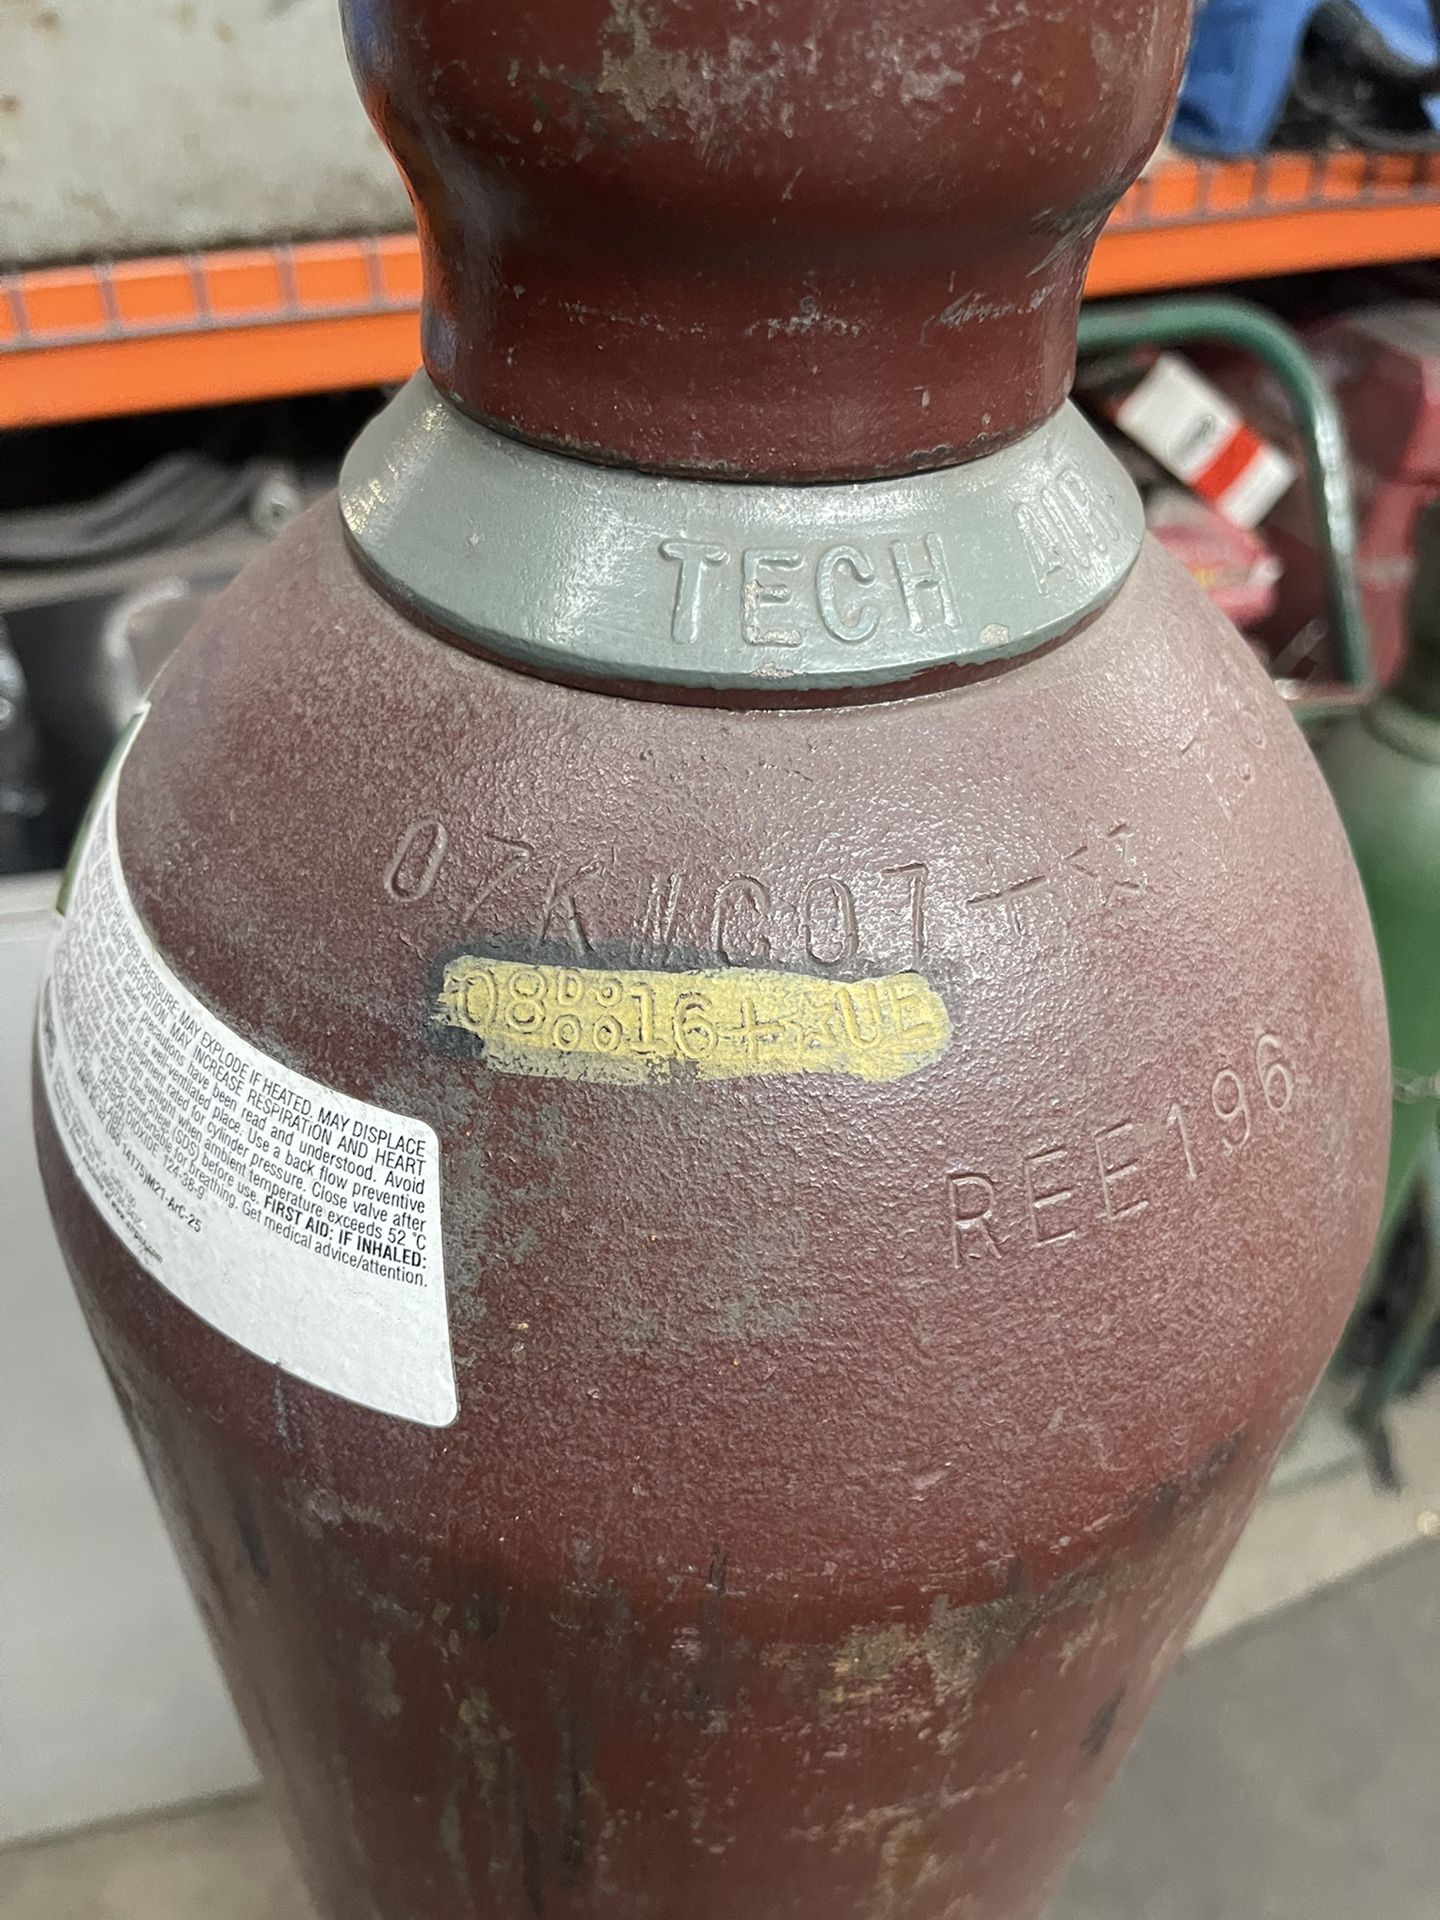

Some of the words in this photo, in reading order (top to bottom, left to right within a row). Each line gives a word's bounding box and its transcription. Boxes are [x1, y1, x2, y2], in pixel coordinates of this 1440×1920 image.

[658, 532, 962, 647] TECH
[1013, 468, 1122, 595] AIR
[125, 1110, 159, 1158] DIOXIDE
[162, 1154, 206, 1200] 124-38-9
[126, 1051, 143, 1079] from
[144, 1077, 176, 1119] sunlight
[178, 1113, 203, 1144] when
[204, 1138, 247, 1177] ambient
[249, 1166, 324, 1218] temperature
[327, 1211, 383, 1240] exceeds
[387, 1228, 406, 1247] 52
[128, 1034, 168, 1088] equipment
[167, 1083, 190, 1112] rated
[191, 1104, 206, 1125] for
[207, 1121, 249, 1159] cylinder
[250, 1152, 307, 1194] pressure.
[311, 1182, 347, 1210] Close
[353, 1201, 388, 1223] valve
[392, 1211, 426, 1233] after
[129, 1076, 147, 1106] Data
[172, 1125, 201, 1163] (SDS)
[201, 1151, 236, 1187] before
[237, 1182, 260, 1206] use.
[264, 1195, 303, 1225] FIRST
[305, 1213, 334, 1241] AID:
[338, 1228, 353, 1246] IF
[357, 1238, 427, 1270] INHALED:
[140, 1011, 185, 1067] precautions
[188, 1060, 210, 1090] have
[212, 1082, 237, 1112] been
[241, 1107, 267, 1131] read
[270, 1125, 294, 1146] and
[300, 1140, 377, 1183] understood.
[384, 1171, 426, 1196] Avoid
[150, 1043, 212, 1111] well-ventilated
[247, 1127, 270, 1153] Use
[273, 1146, 281, 1158] a
[284, 1149, 315, 1176] back
[320, 1166, 349, 1190] flow
[351, 1180, 426, 1214] preventive
[170, 1022, 192, 1050] MAY
[193, 1045, 245, 1096] INCREASE
[247, 1088, 333, 1146] RESPIRATION
[337, 1136, 369, 1159] AND
[375, 1148, 426, 1176] HEART
[180, 1010, 201, 1038] MAY
[200, 1031, 249, 1080] EXPLODE
[249, 1069, 262, 1086] IF
[263, 1077, 314, 1119] HEATED.
[318, 1107, 350, 1132] MAY
[352, 1120, 426, 1157] DISPLACE
[127, 1095, 173, 1154] comfortable
[174, 1146, 188, 1166] for
[189, 1161, 239, 1210] breathing.
[242, 1199, 262, 1225] Get
[264, 1216, 312, 1250] medical
[315, 1241, 429, 1288] advice/attention.
